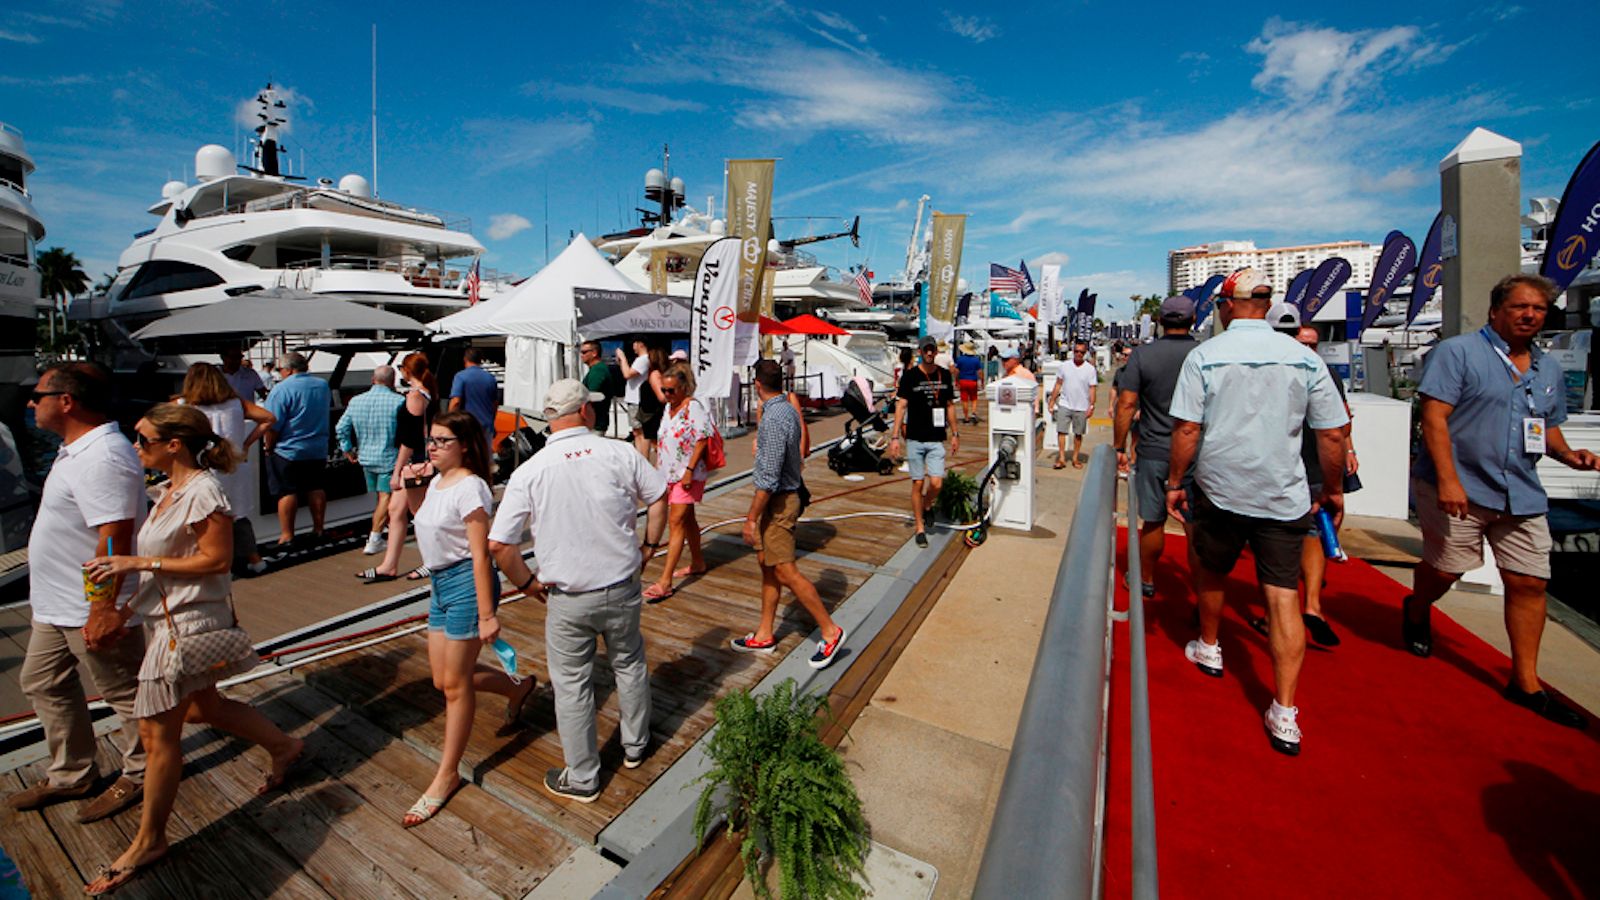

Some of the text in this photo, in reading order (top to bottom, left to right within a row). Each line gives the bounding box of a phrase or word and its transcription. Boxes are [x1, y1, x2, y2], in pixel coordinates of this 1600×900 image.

[742, 181, 758, 309] MAJESTY YACHTS
[1383, 243, 1411, 288] HORIZON
[1316, 261, 1344, 298] HORIZON
[629, 318, 665, 329] MAJESTY
[694, 259, 720, 377] Vanquish
